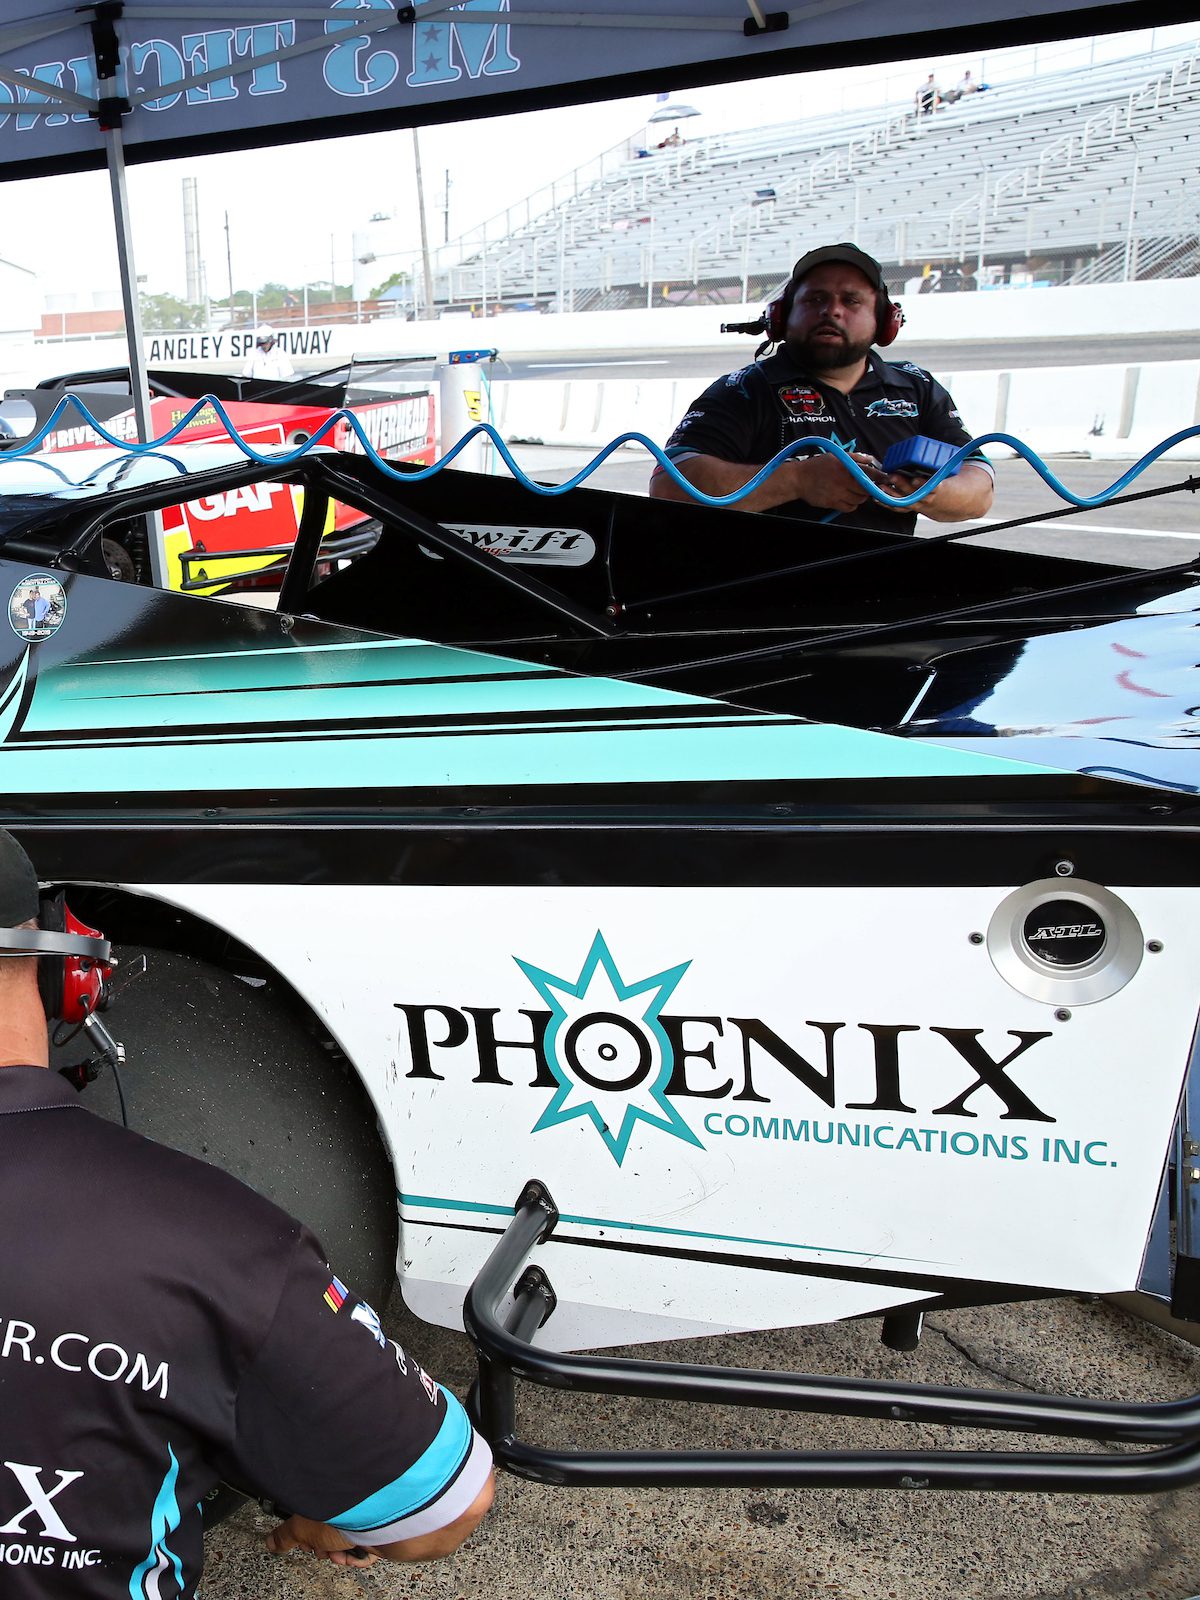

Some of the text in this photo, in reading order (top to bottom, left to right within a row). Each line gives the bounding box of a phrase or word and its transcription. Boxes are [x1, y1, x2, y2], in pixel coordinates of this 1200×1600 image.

[150, 335, 223, 361] ANGLEY
[189, 481, 285, 521] GAF
[1028, 924, 1102, 940] ATL
[393, 1003, 1057, 1123] PHOENIX
[703, 1111, 1118, 1168] COMMUNICATIONS INC.
[62, 1549, 102, 1570] INC.
